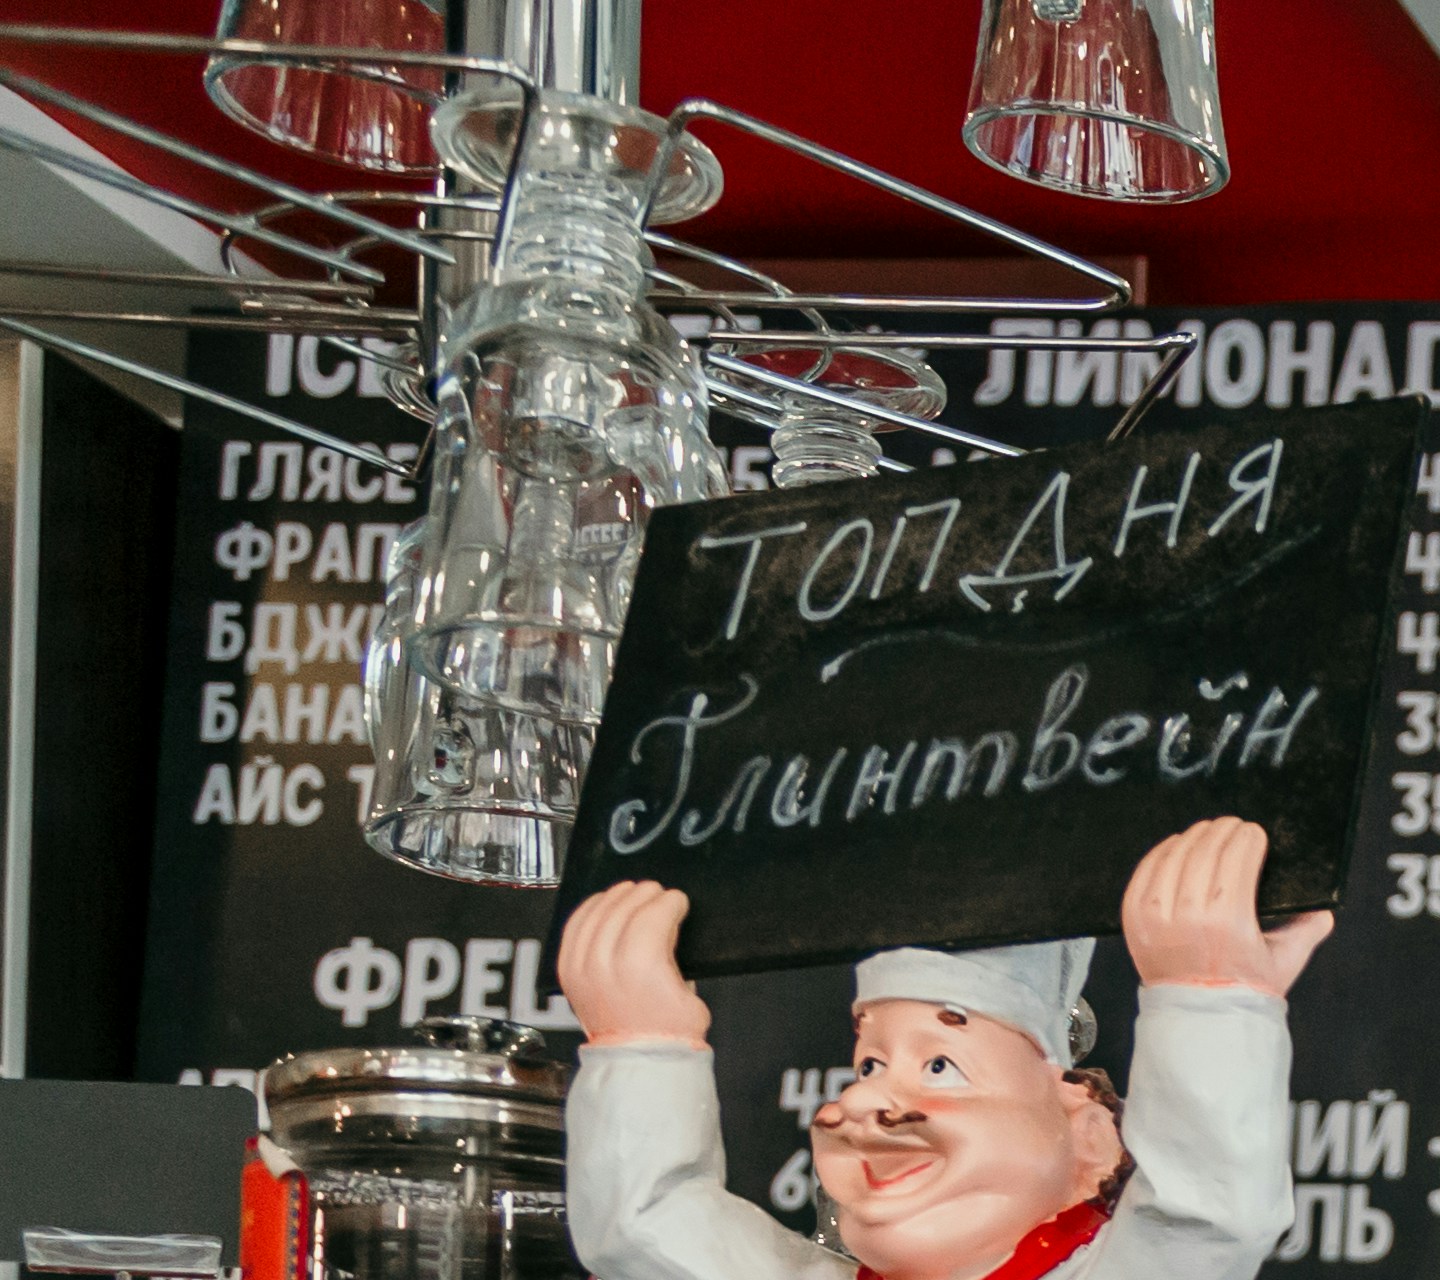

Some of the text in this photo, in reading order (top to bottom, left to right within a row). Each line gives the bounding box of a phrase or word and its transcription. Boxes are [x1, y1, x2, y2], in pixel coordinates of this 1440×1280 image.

[693, 439, 1284, 640] ТОП ДНЯ
[193, 762, 325, 827] АЙС
